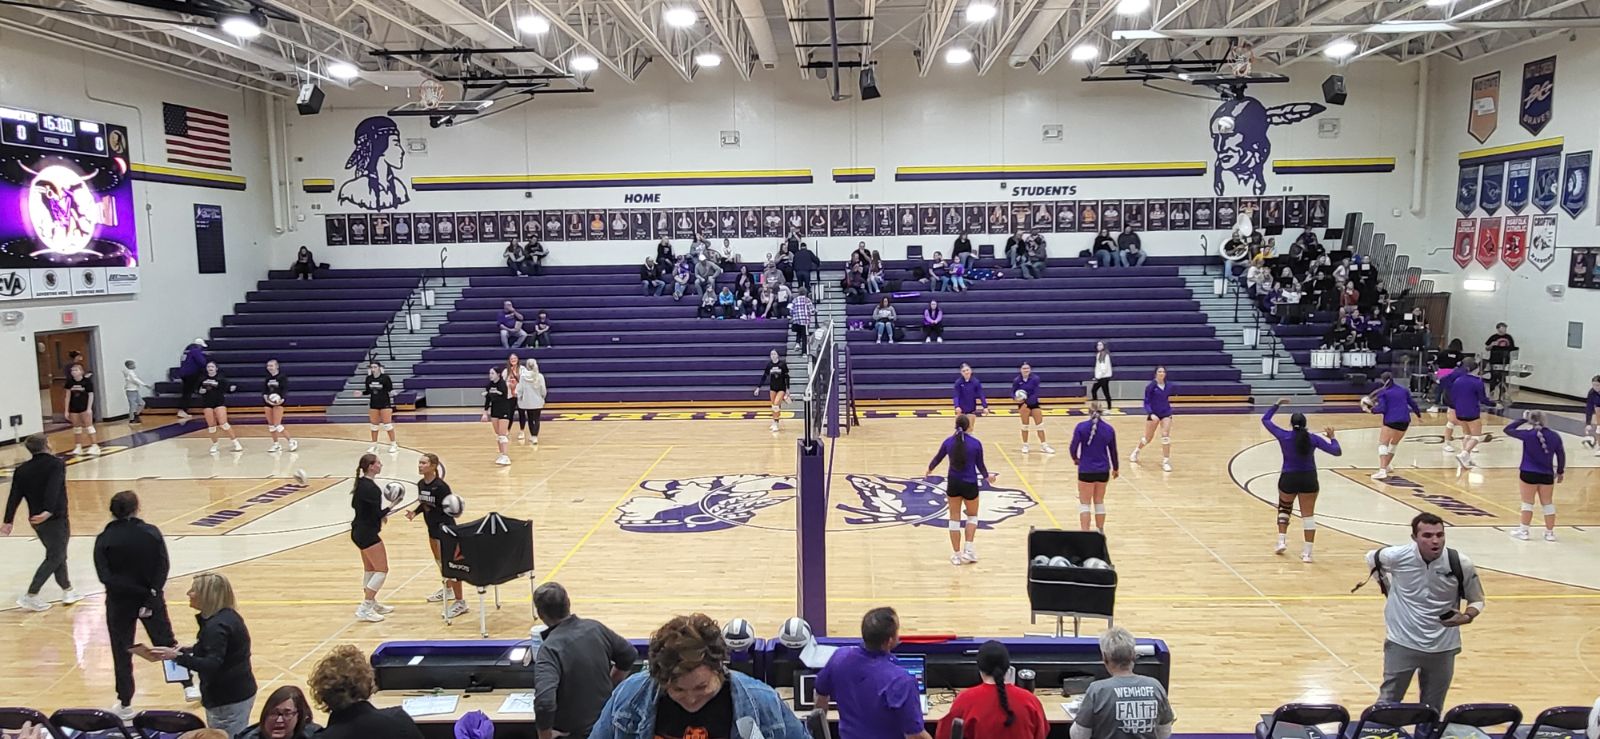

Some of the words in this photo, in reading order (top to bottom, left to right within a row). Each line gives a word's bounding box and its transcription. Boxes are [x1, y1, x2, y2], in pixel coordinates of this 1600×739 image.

[17, 124, 27, 140] 0
[95, 137, 104, 151] 0
[1011, 185, 1077, 196] STUDENTS
[624, 193, 661, 203] HOME
[1534, 217, 1556, 226] CROFTON
[1114, 686, 1154, 698] WEMHOFF
[1116, 700, 1158, 720] FAITH
